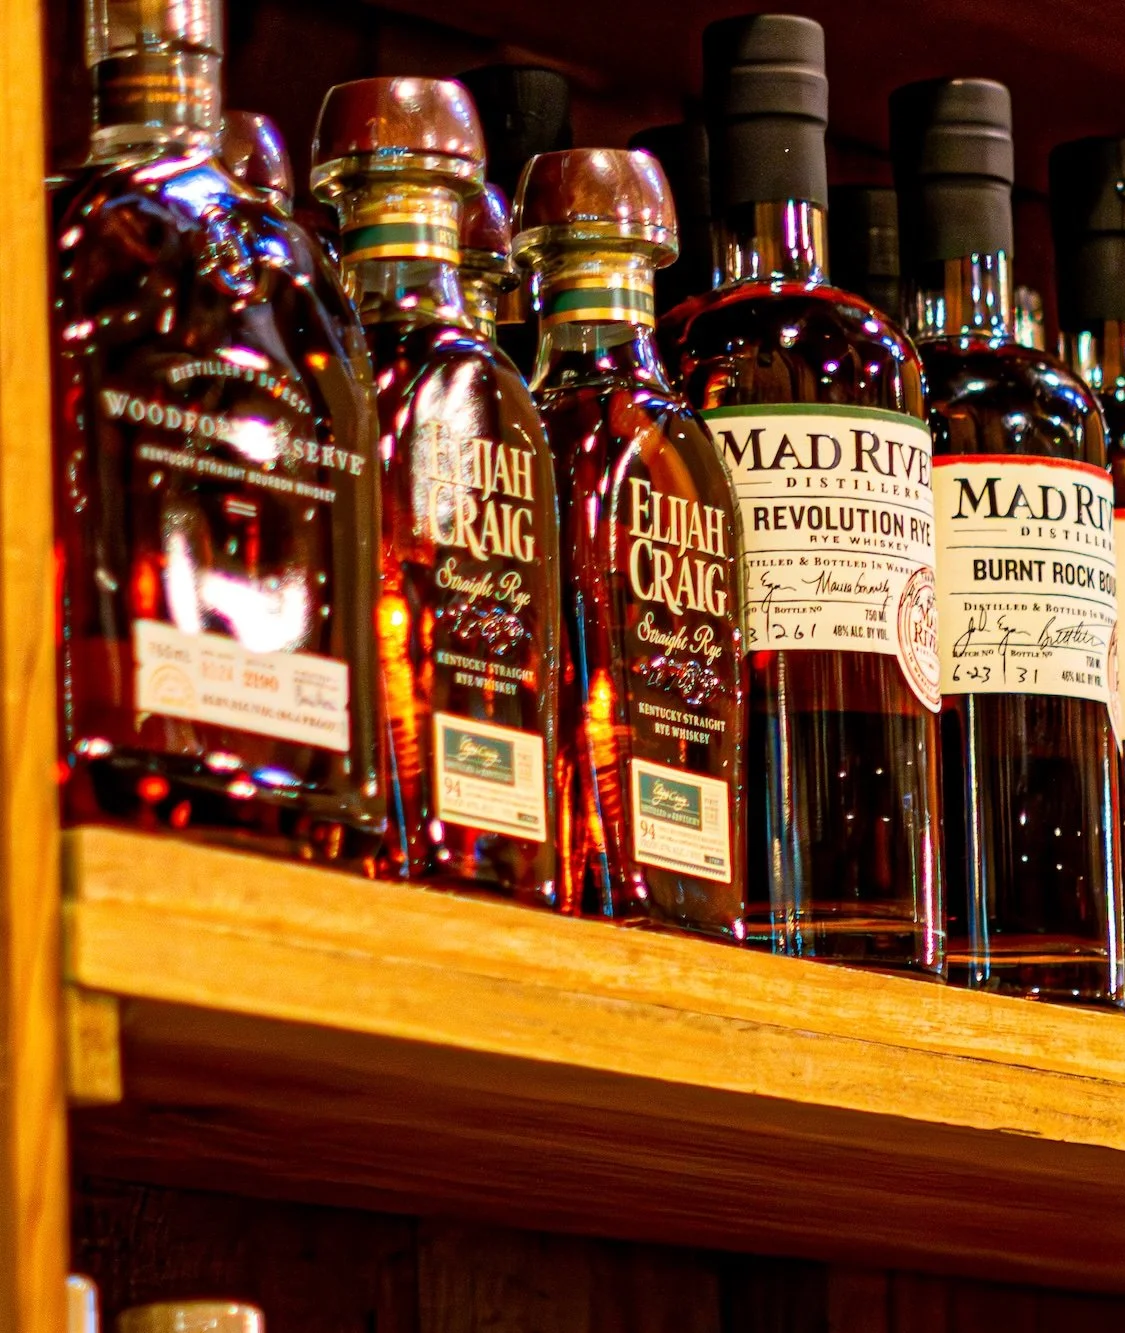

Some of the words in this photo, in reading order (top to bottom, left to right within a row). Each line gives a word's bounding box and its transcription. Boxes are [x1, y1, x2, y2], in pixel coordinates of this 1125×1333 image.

[197, 459, 246, 480] STRAIGHT
[429, 421, 535, 501] ELIJAH
[786, 477, 919, 501] DISTILLERS
[429, 481, 535, 562] CRAIG
[629, 477, 727, 558] ELIJAH
[753, 505, 905, 539] REVOLUTION
[910, 516, 932, 547] RYE
[809, 535, 840, 544] RYE
[849, 536, 909, 552] WHISKEY
[814, 558, 867, 569] BOTTLED
[973, 559, 1046, 583] BURNT
[1052, 562, 1096, 589] ROCK
[436, 557, 494, 604] Straight
[495, 569, 531, 613] Rye
[629, 538, 729, 617] CRAIG
[774, 606, 808, 614] BOTTLE
[865, 609, 879, 621] 750
[963, 602, 1028, 612] DISTILLED
[1045, 603, 1087, 617] BOTTLED
[637, 611, 687, 656] Straight
[689, 624, 722, 666] Rye
[772, 623, 817, 640] 261
[437, 650, 487, 674] KENTUCKY
[488, 662, 534, 683] STRAIGHT
[952, 664, 992, 683] 6-23
[1016, 667, 1038, 684] 31
[456, 671, 474, 688] RYE
[474, 676, 517, 696] WHISKEY
[638, 702, 683, 724] KENTUCKY
[684, 712, 726, 733] STRAIGHT
[655, 722, 671, 737] RYE
[672, 728, 710, 745] WHISKEY
[444, 778, 461, 797] 94
[640, 820, 656, 839] 94
